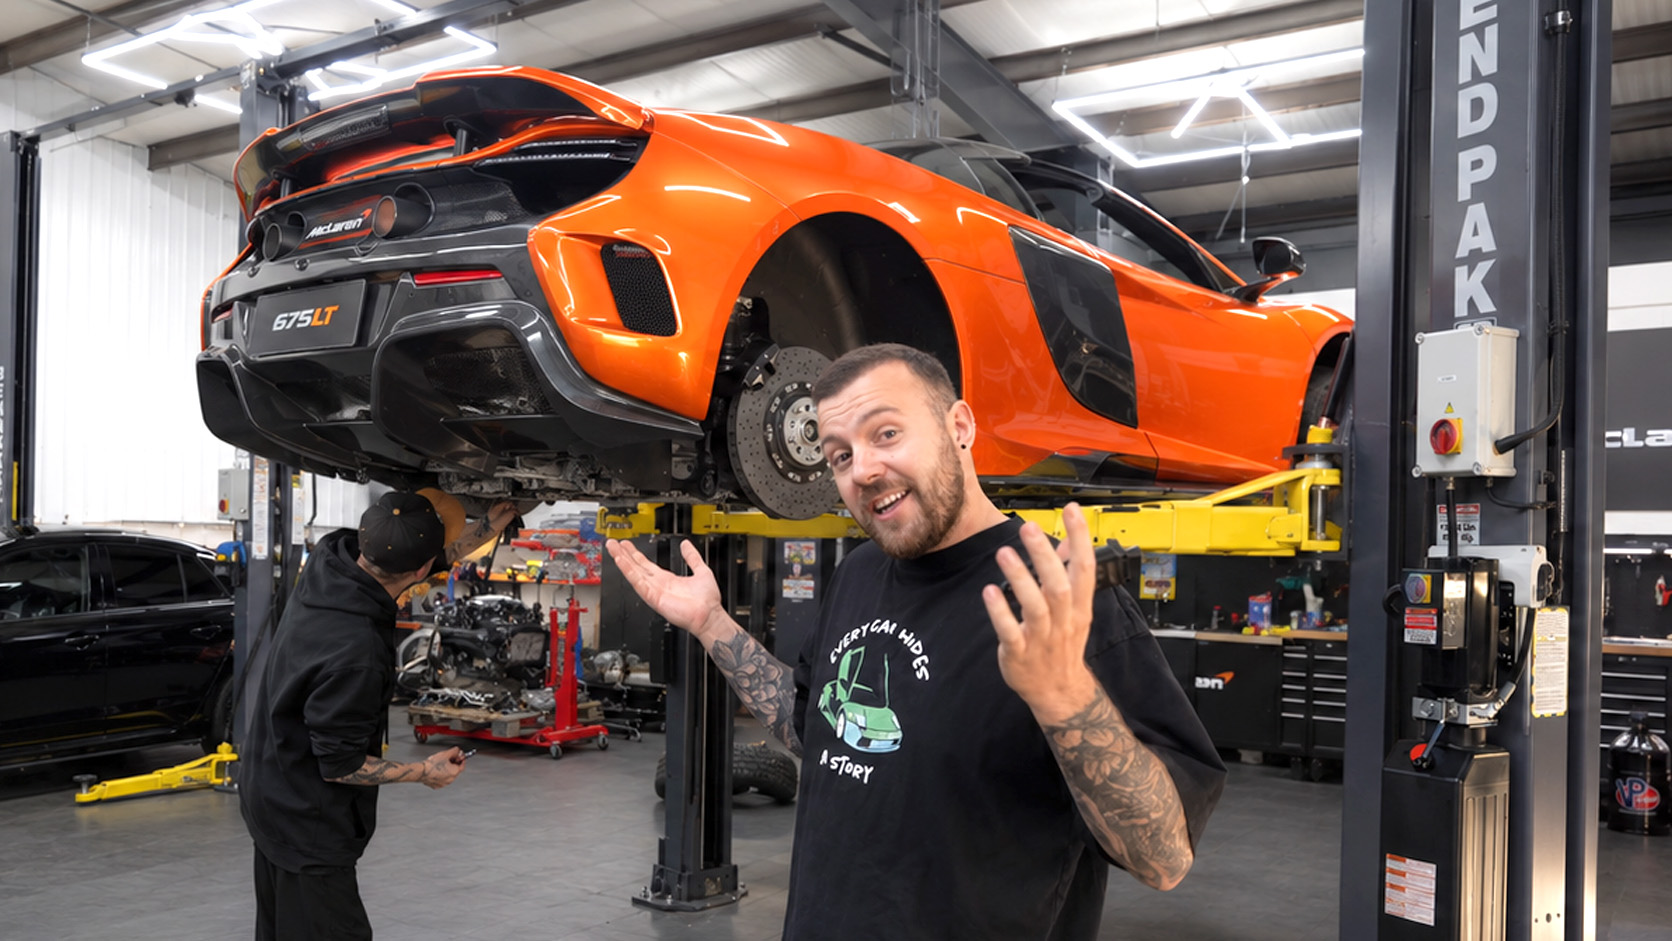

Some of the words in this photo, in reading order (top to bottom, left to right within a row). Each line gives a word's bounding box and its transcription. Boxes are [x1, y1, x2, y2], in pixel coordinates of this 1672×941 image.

[305, 217, 364, 240] McLaren
[272, 304, 340, 331] 675LT
[898, 628, 930, 681] HIDES
[819, 749, 829, 765] A
[829, 755, 874, 784] STORY
